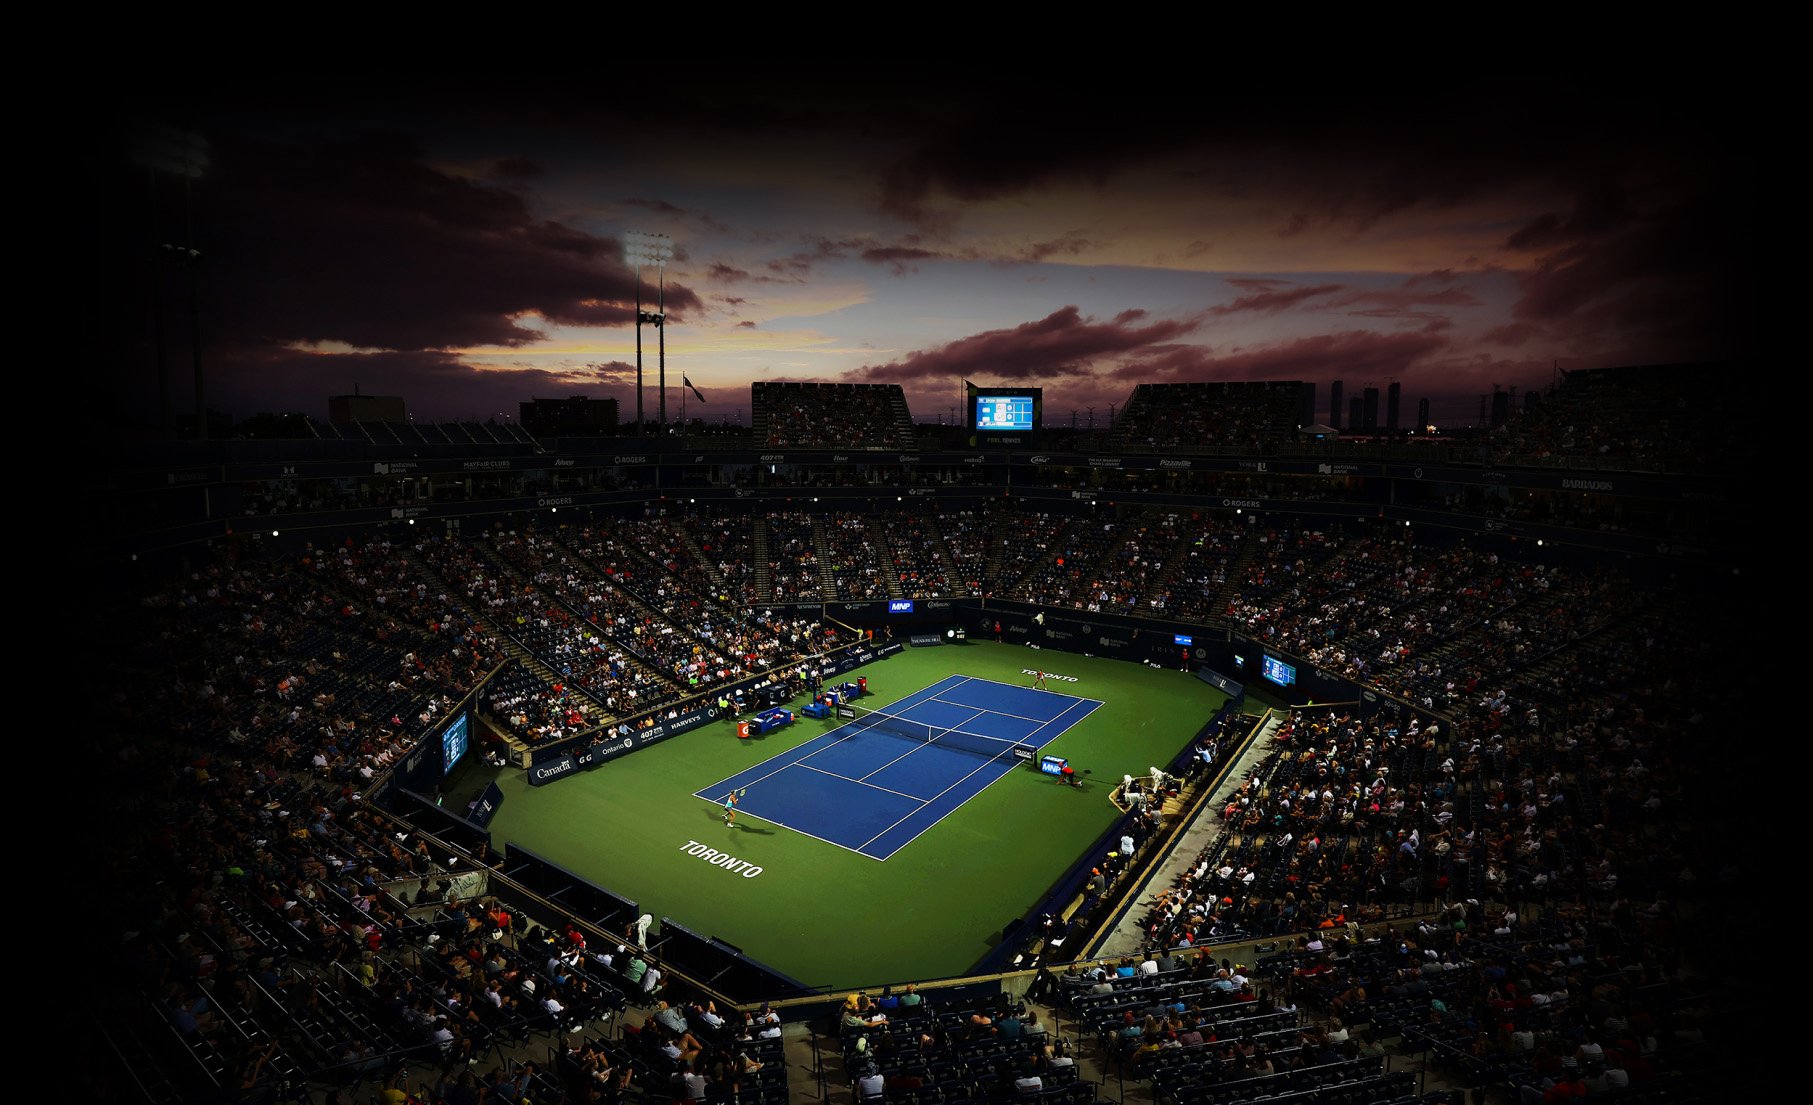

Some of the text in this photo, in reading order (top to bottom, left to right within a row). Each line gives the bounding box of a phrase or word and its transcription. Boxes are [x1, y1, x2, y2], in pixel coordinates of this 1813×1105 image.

[1562, 479, 1614, 490] BARBADOS
[546, 497, 572, 505] ROGERS
[1231, 500, 1260, 508] ROGERS
[891, 602, 911, 611] MNP
[1021, 669, 1079, 682] TOONTO
[640, 730, 653, 740] 407
[602, 743, 625, 755] Ontario
[536, 760, 571, 779] Canada
[1042, 763, 1061, 773] MNP
[679, 839, 763, 878] TORONTO
